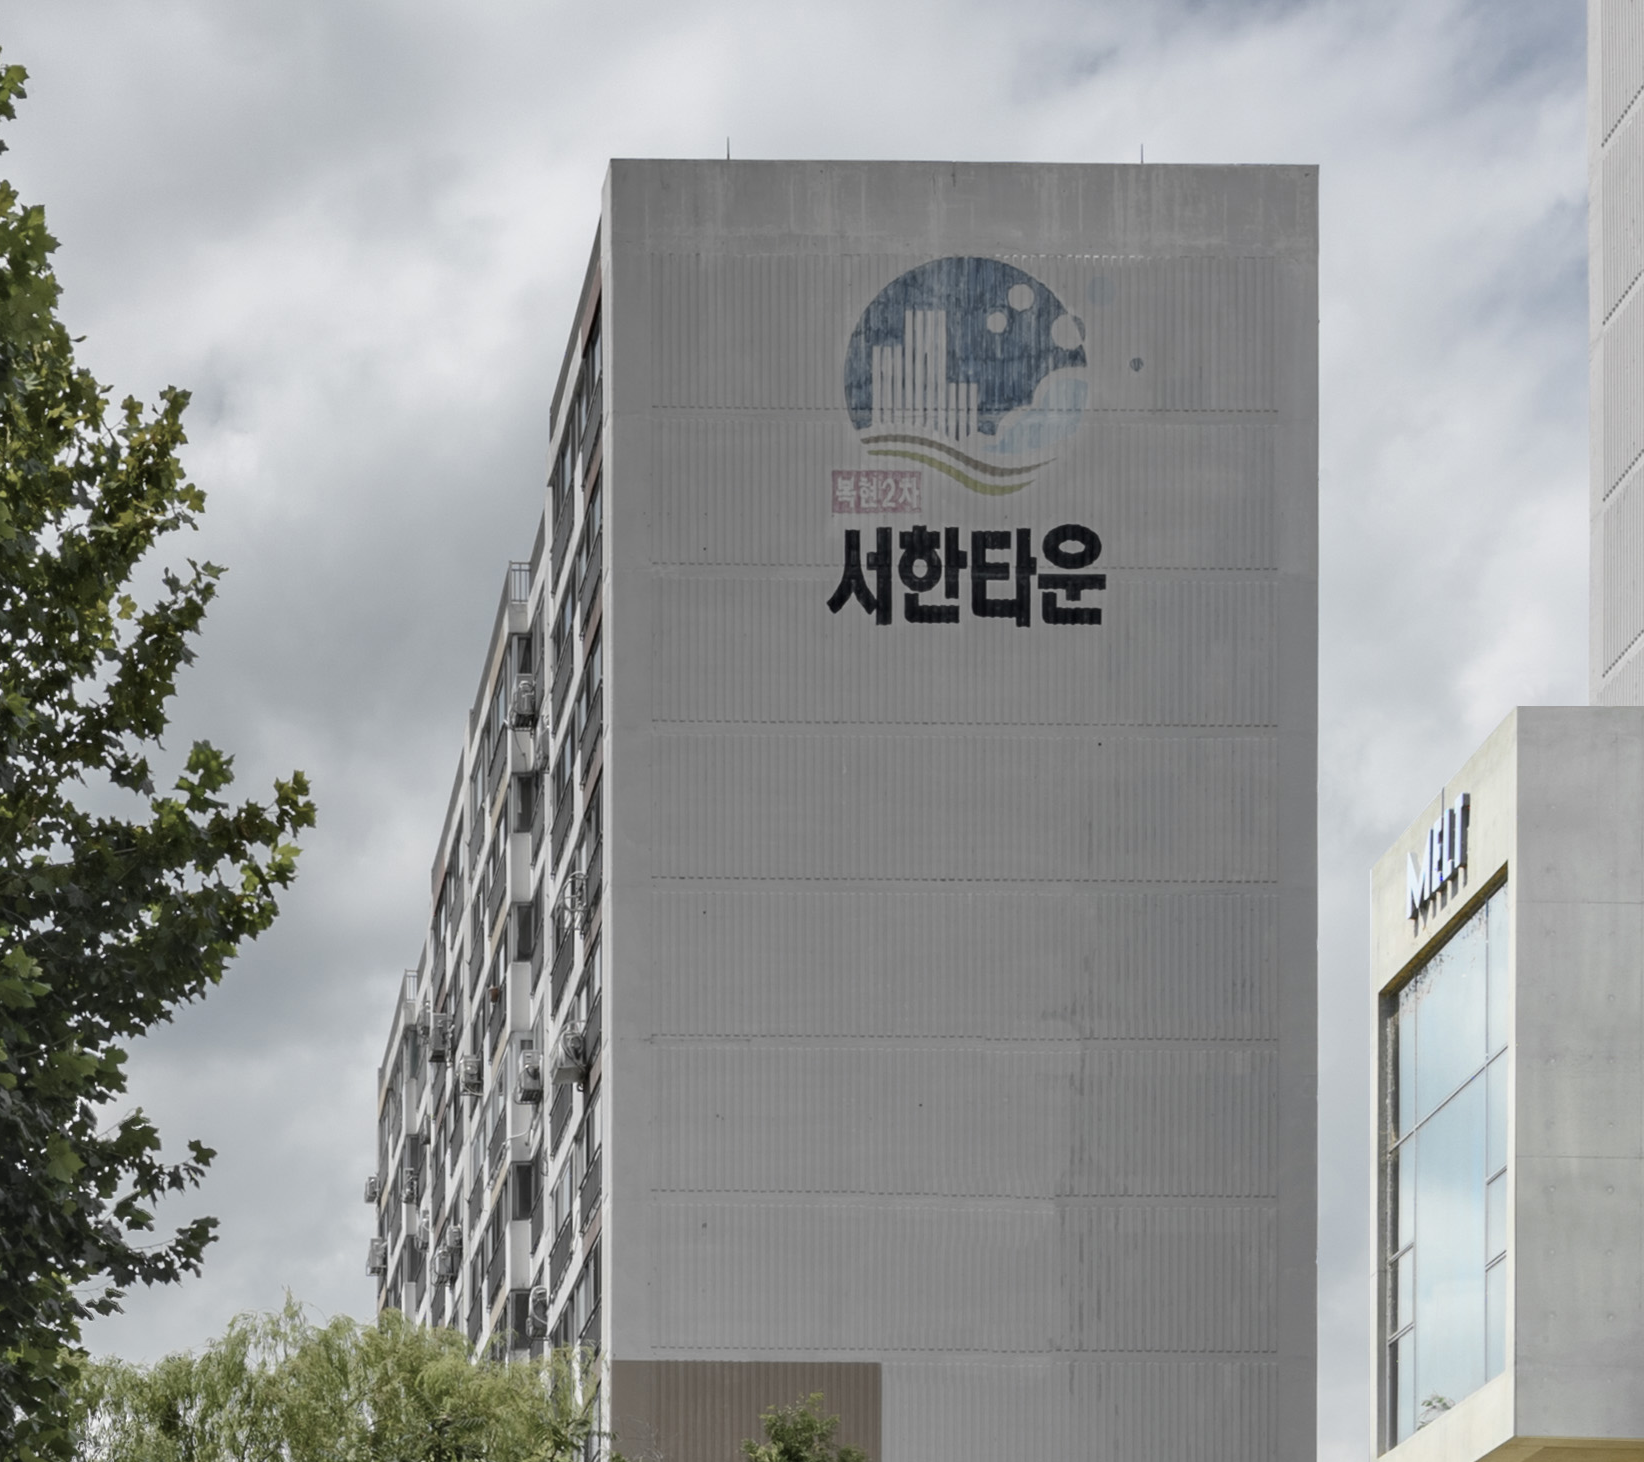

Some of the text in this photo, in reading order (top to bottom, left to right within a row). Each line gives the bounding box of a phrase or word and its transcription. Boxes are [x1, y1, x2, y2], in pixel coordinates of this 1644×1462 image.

[836, 476, 920, 508] 복현2차
[826, 523, 1107, 628] 서한타운
[1406, 792, 1470, 920] MELT
